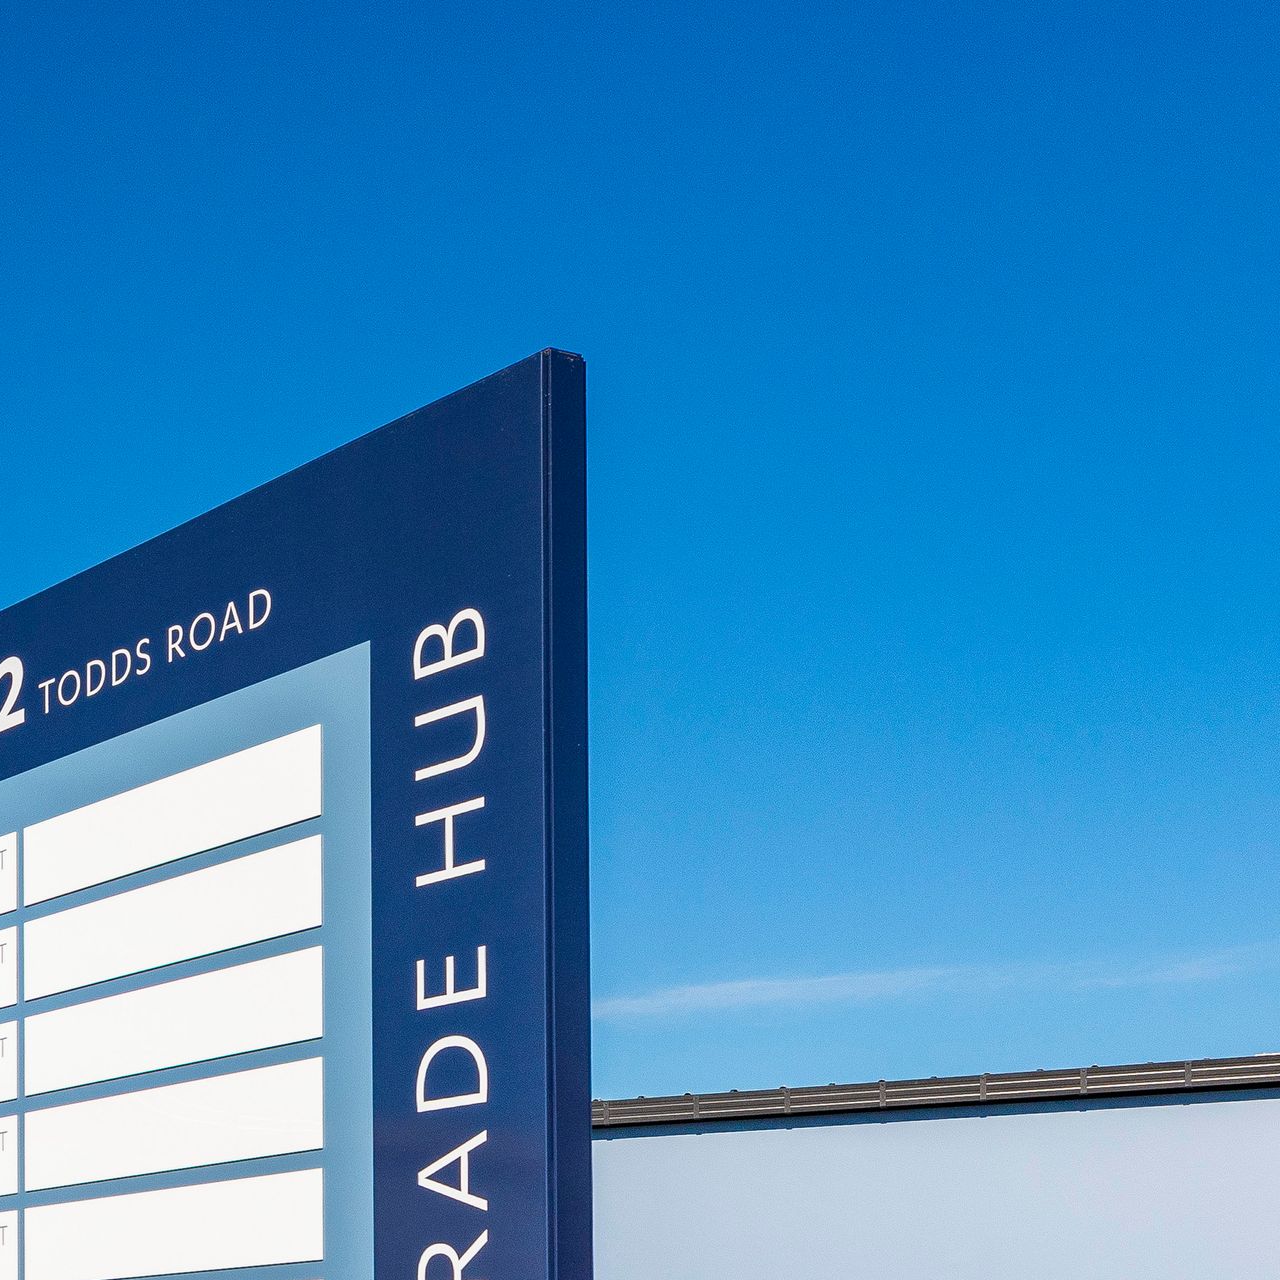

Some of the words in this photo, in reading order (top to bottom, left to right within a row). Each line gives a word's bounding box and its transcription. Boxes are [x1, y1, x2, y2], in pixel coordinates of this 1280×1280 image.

[38, 637, 151, 714] TODDS
[168, 588, 272, 663] ROAD
[413, 608, 486, 888] HUB
